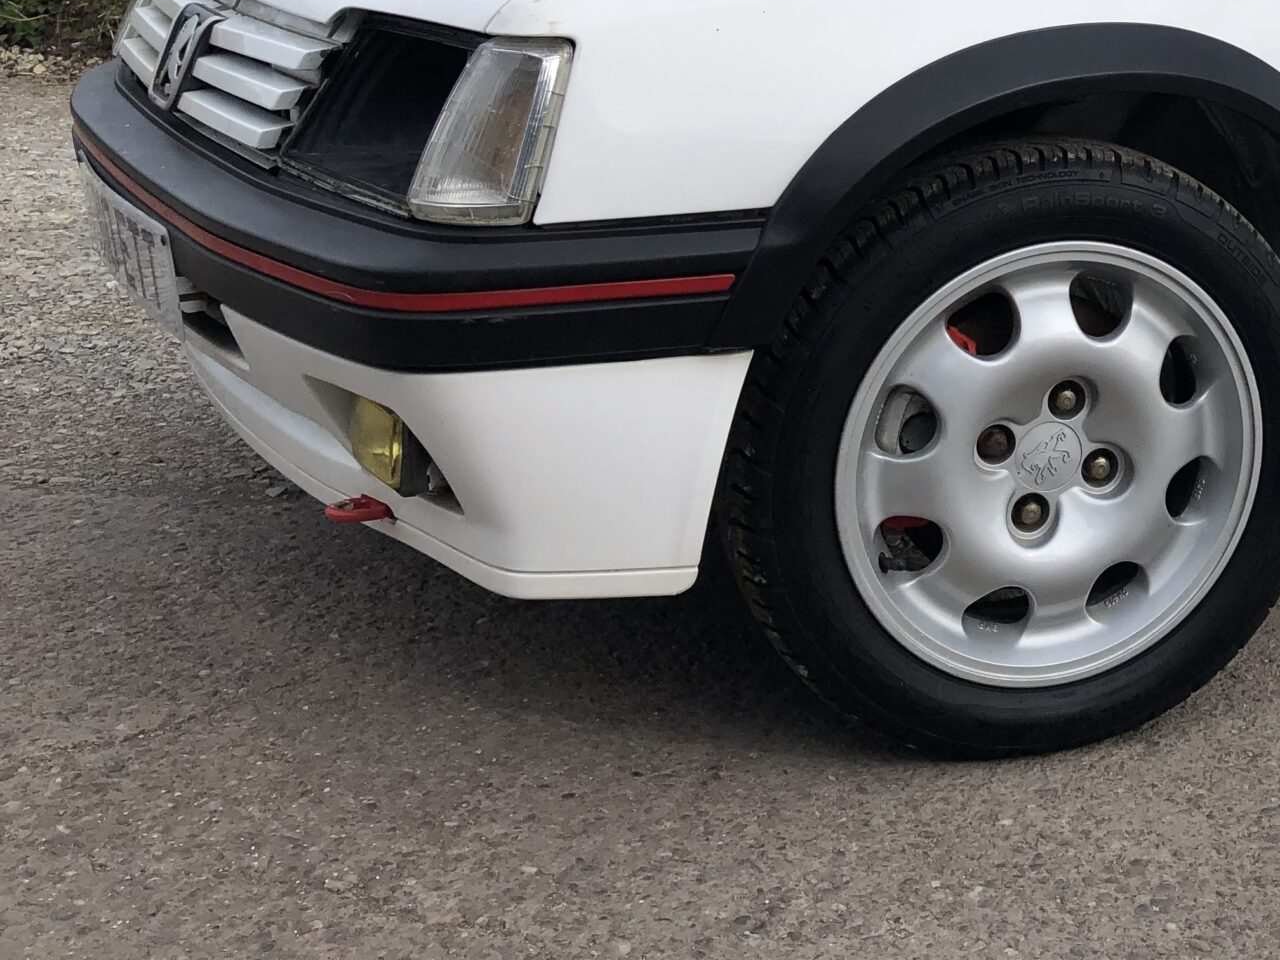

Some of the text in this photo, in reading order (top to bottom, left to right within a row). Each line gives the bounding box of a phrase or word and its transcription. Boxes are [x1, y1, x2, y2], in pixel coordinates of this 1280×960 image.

[1016, 170, 1080, 185] TECHNOLOGY
[1022, 192, 1167, 218] RainSport 3
[1217, 233, 1268, 285] OUTSIDE
